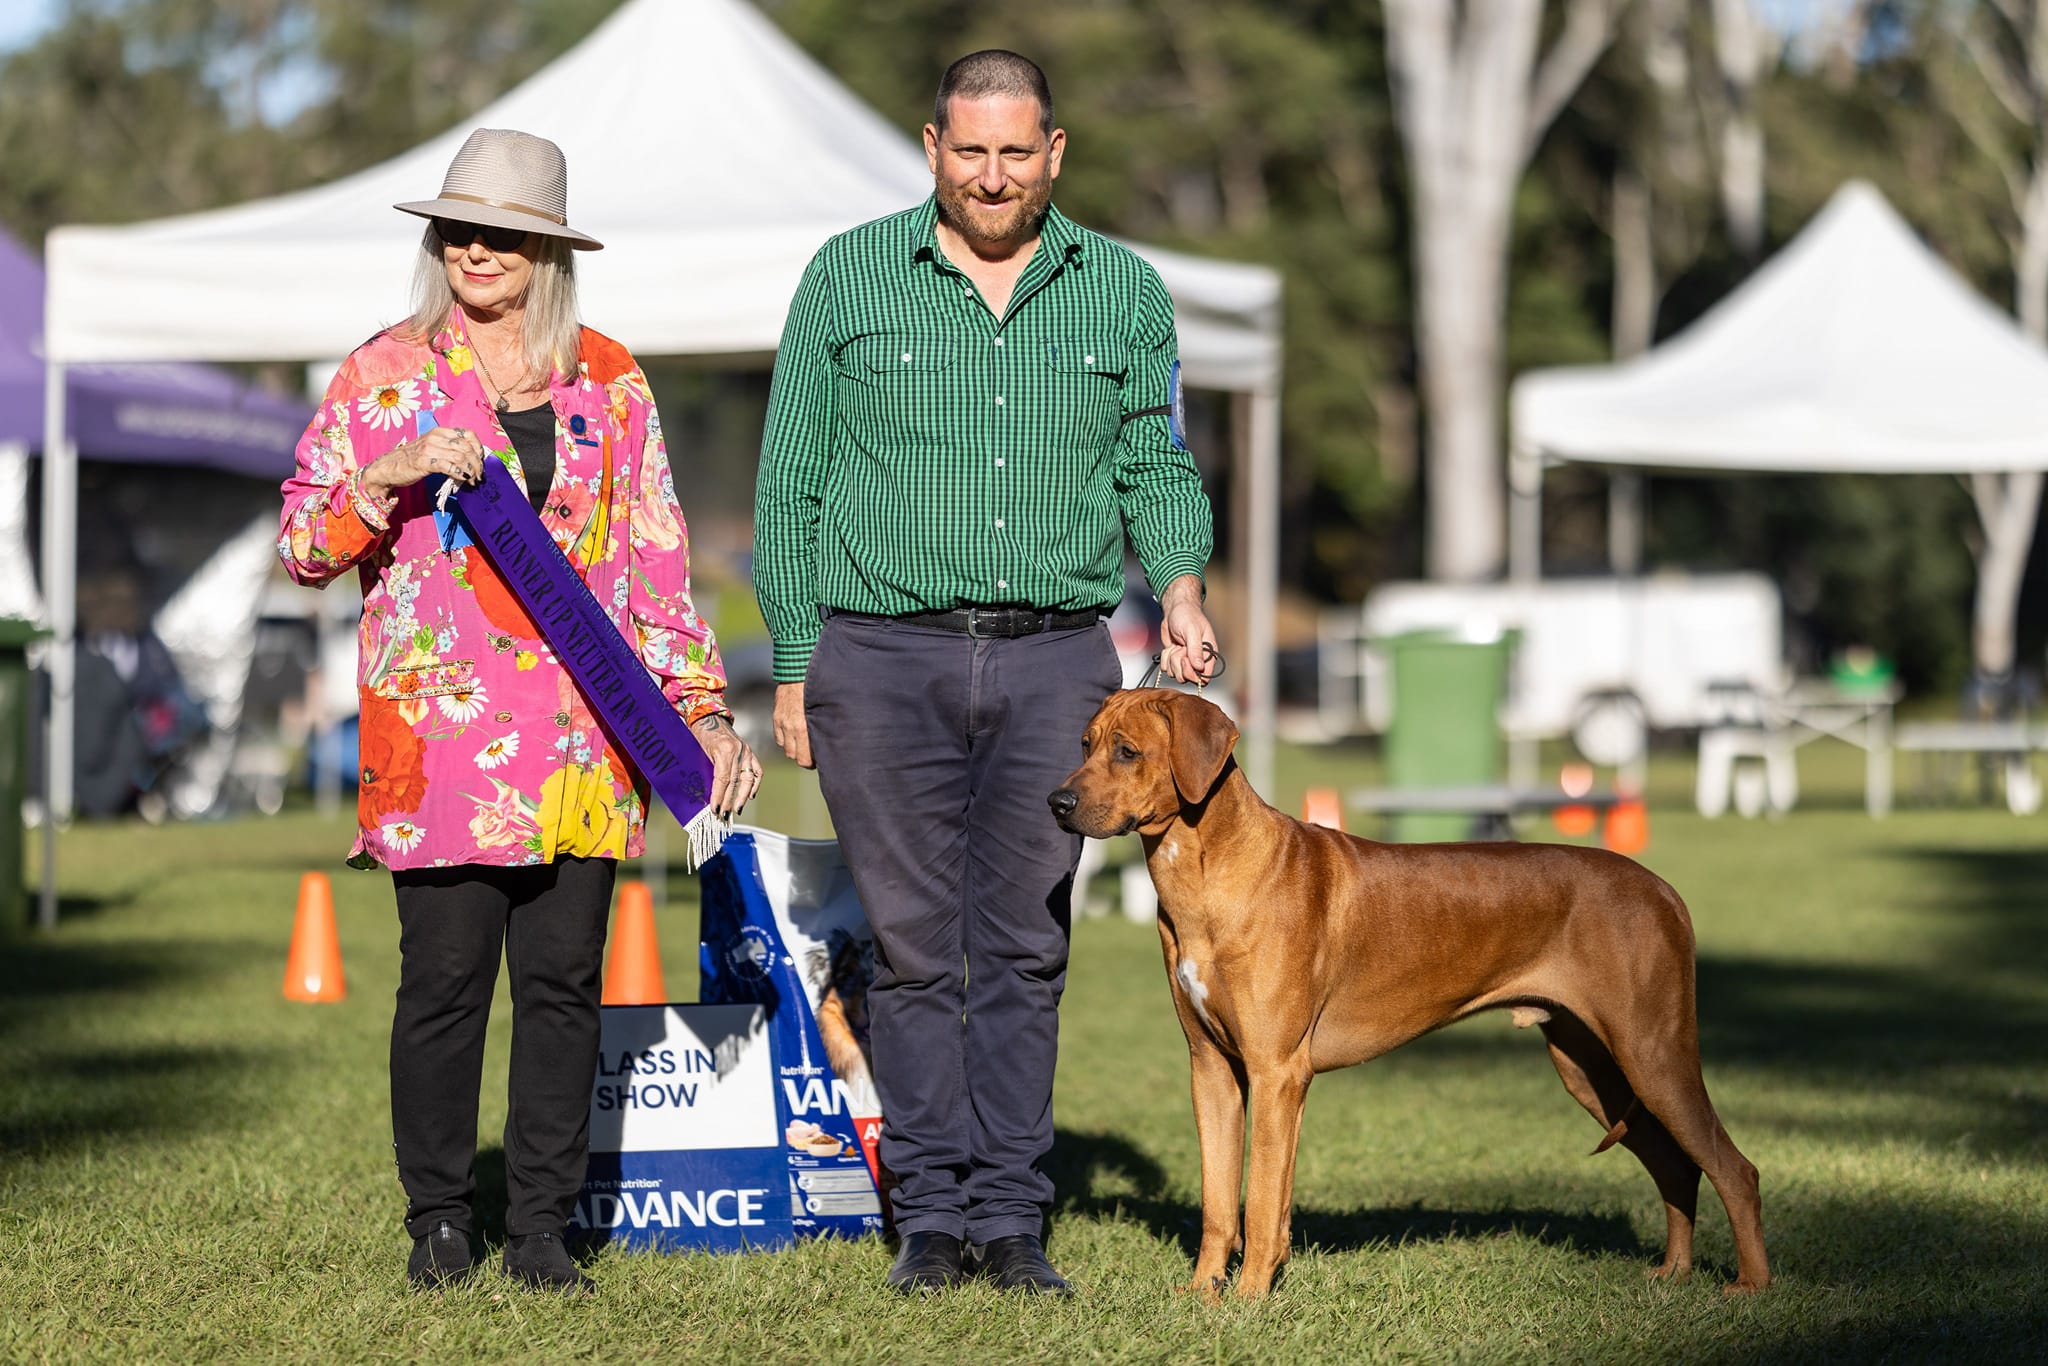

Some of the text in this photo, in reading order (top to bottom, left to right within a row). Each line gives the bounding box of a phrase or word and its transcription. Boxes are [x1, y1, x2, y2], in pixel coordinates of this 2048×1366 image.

[547, 538, 671, 711] BROOKFIELD SHOW SOCIETY
[490, 517, 680, 776] RUNNER UP NEUTER IN SHOW
[600, 1048, 716, 1077] LASS IN
[597, 1083, 698, 1111] SHOW
[594, 1180, 613, 1190] Pet
[569, 1189, 766, 1229] ADVANCE
